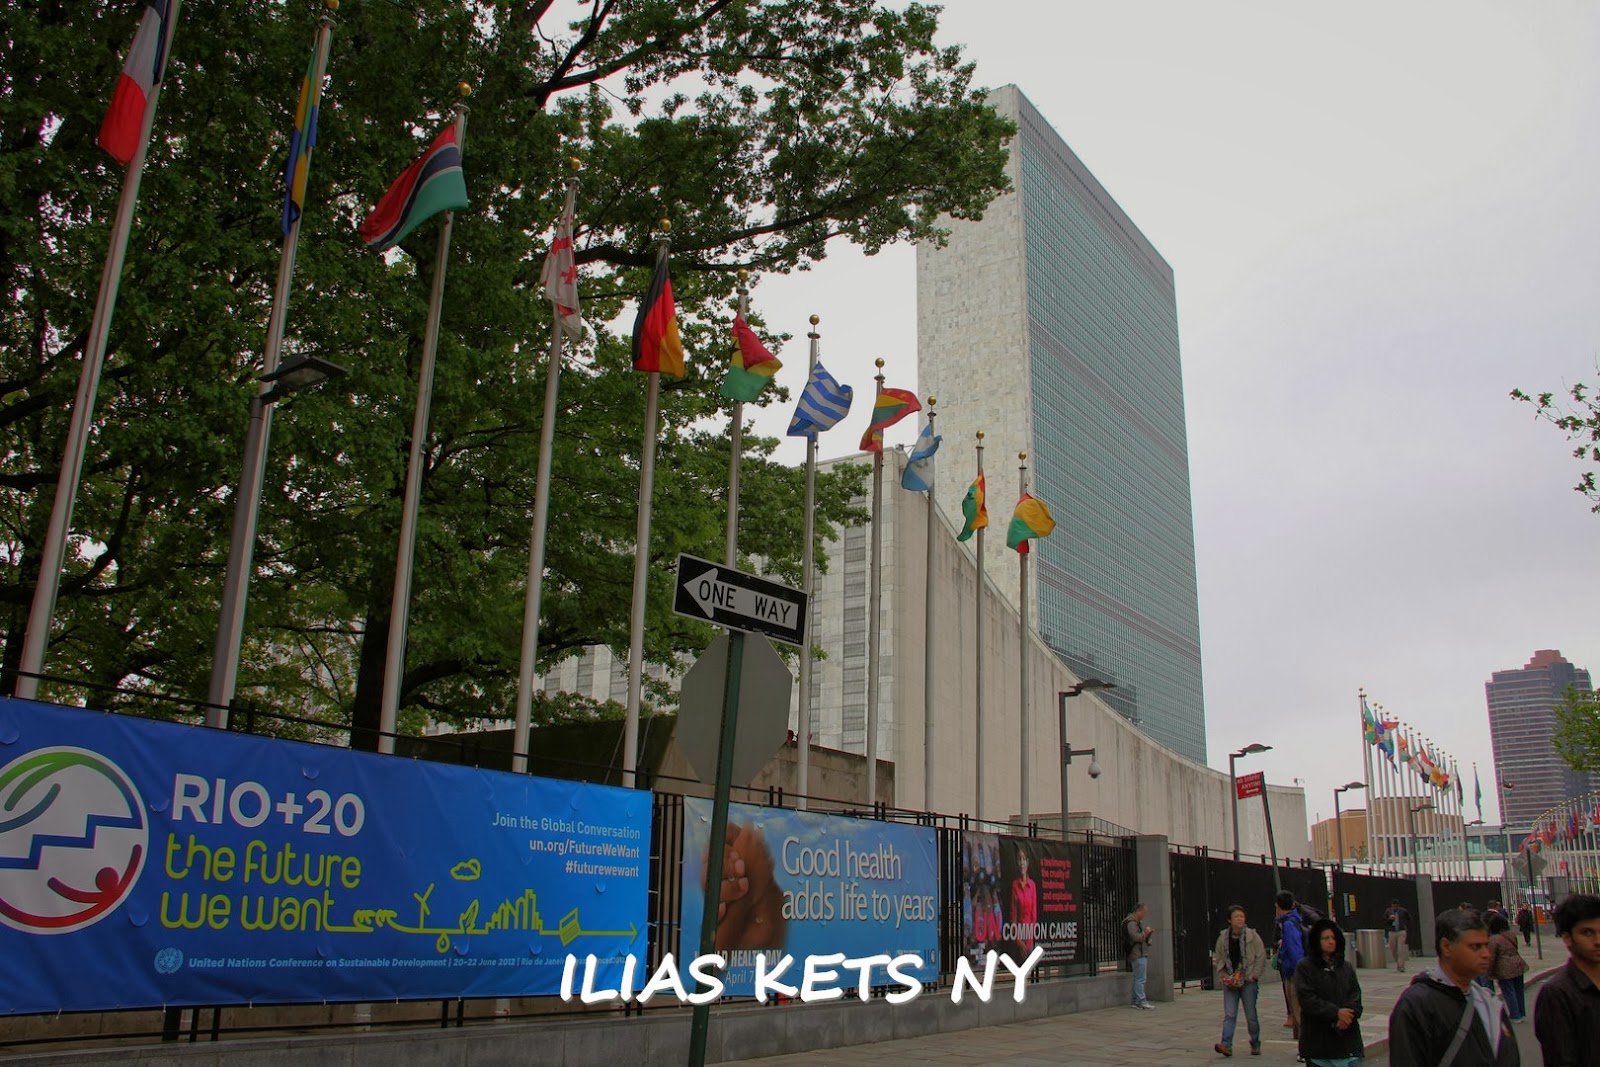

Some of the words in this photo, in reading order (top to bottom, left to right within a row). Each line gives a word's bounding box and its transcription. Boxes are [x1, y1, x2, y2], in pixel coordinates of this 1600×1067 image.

[699, 580, 736, 609] ONE
[755, 595, 791, 624] WAY
[171, 773, 366, 837] RIO+20
[492, 812, 517, 828] Join
[520, 816, 538, 830] the
[541, 818, 575, 834] Global
[577, 821, 640, 840] Conversation
[165, 832, 235, 881] the
[244, 840, 361, 888] future
[529, 839, 640, 859] un.org/FutureWeWant
[782, 836, 840, 877] Good
[845, 838, 902, 880] health
[565, 860, 640, 877] #futurewewant
[160, 890, 231, 929] we
[240, 890, 335, 932] want
[781, 880, 835, 921] adds
[840, 881, 868, 920] life
[871, 886, 890, 921] to
[895, 893, 935, 929] years
[1003, 922, 1047, 941] COMMON
[1050, 921, 1078, 940] CAUSE
[189, 957, 225, 968] United
[227, 957, 267, 968] Nations
[269, 957, 324, 968] Conference
[326, 959, 337, 968] on
[338, 957, 390, 968] Sustainable
[392, 957, 447, 968] Development
[453, 957, 477, 967] 20-22
[479, 957, 496, 967] June
[498, 957, 515, 967] 2012
[521, 957, 532, 966] Rio
[534, 957, 543, 966] de
[766, 949, 783, 966] DAY
[725, 970, 747, 988] April
